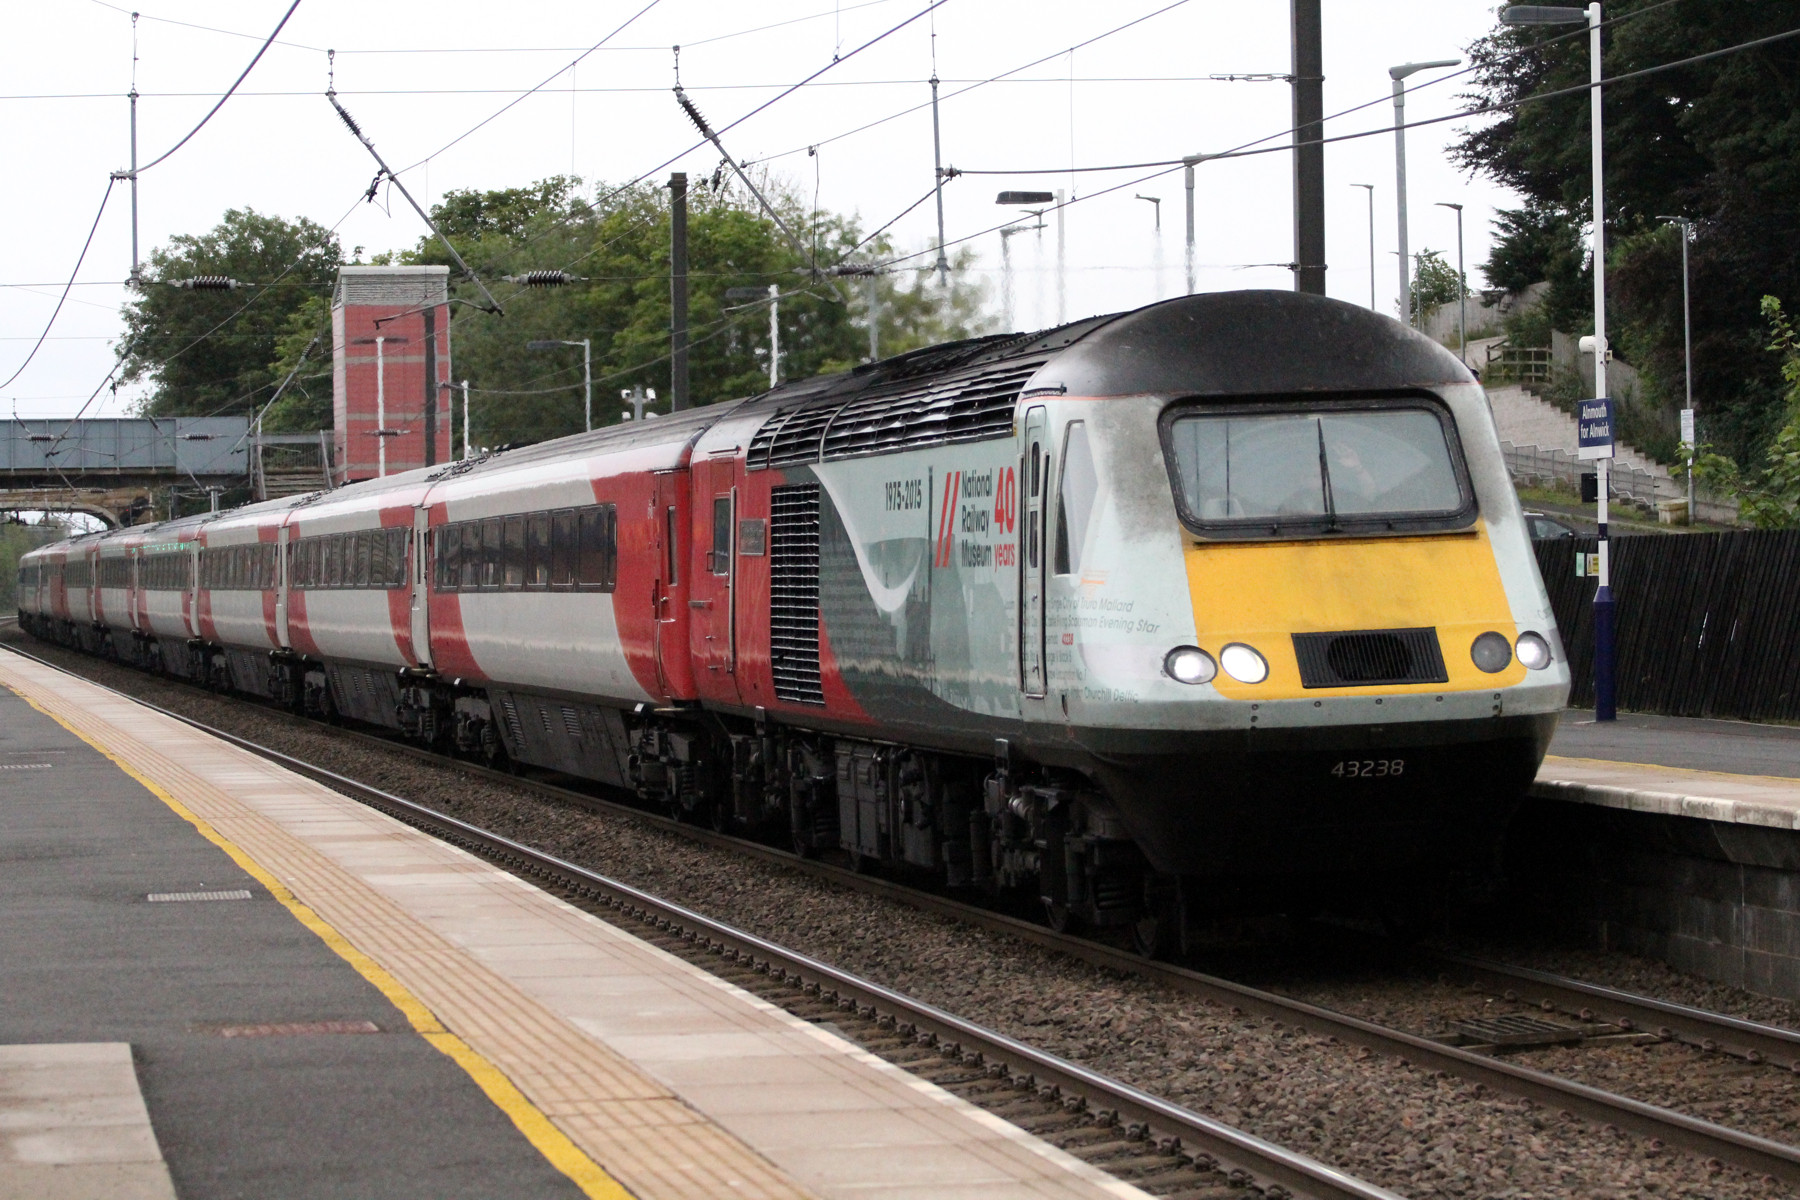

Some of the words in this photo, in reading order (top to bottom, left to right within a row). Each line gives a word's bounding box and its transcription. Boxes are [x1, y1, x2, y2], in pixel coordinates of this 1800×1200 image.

[1582, 402, 1607, 420] Alnmouth
[1580, 423, 1588, 439] for
[1589, 421, 1609, 438] Alnwick
[885, 479, 922, 511] 1975-2015
[961, 467, 993, 499] National
[994, 466, 1015, 535] 40
[961, 503, 990, 538] Railway
[961, 539, 992, 568] Museum
[994, 543, 1015, 573] years
[1099, 599, 1134, 613] Mallard
[1100, 615, 1134, 634] Evening
[1136, 619, 1160, 634] Star
[1084, 685, 1112, 700] Churchill
[1113, 688, 1139, 703] Deltic
[1330, 759, 1404, 778] 43238
